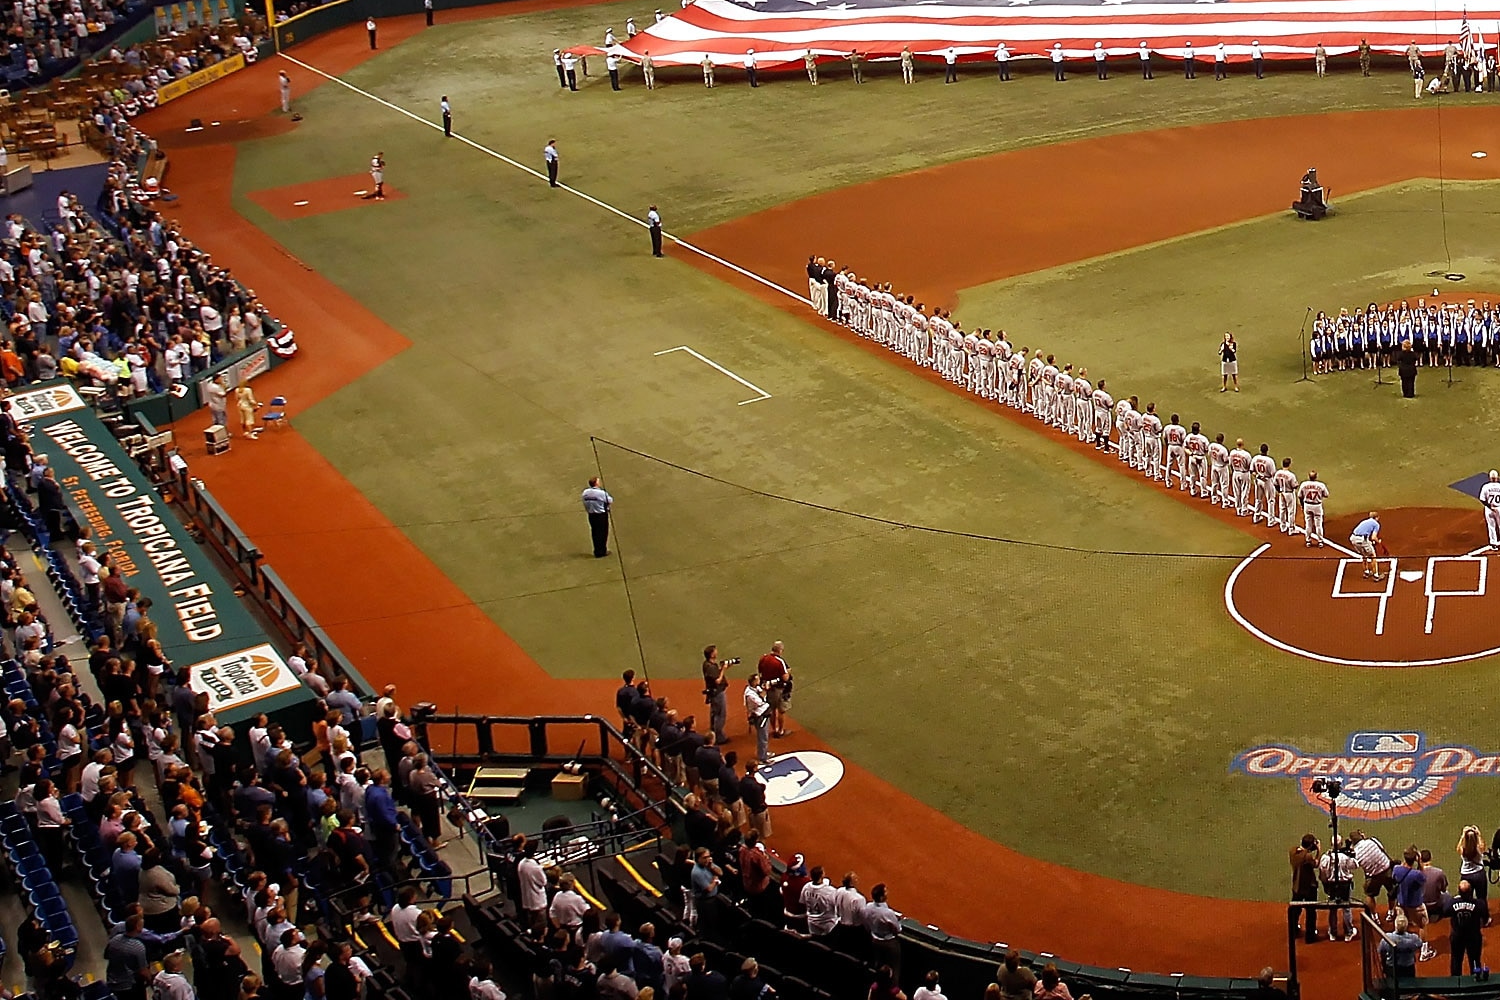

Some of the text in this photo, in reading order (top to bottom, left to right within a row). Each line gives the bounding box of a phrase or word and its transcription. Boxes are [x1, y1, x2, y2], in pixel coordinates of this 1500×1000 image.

[42, 418, 223, 642] WELCOME TO TROPICANA FIELD
[107, 539, 140, 578] FLORIDA
[219, 656, 259, 696] Tropicana
[1240, 747, 1414, 775] OPENING
[1345, 776, 1416, 790] 2010
